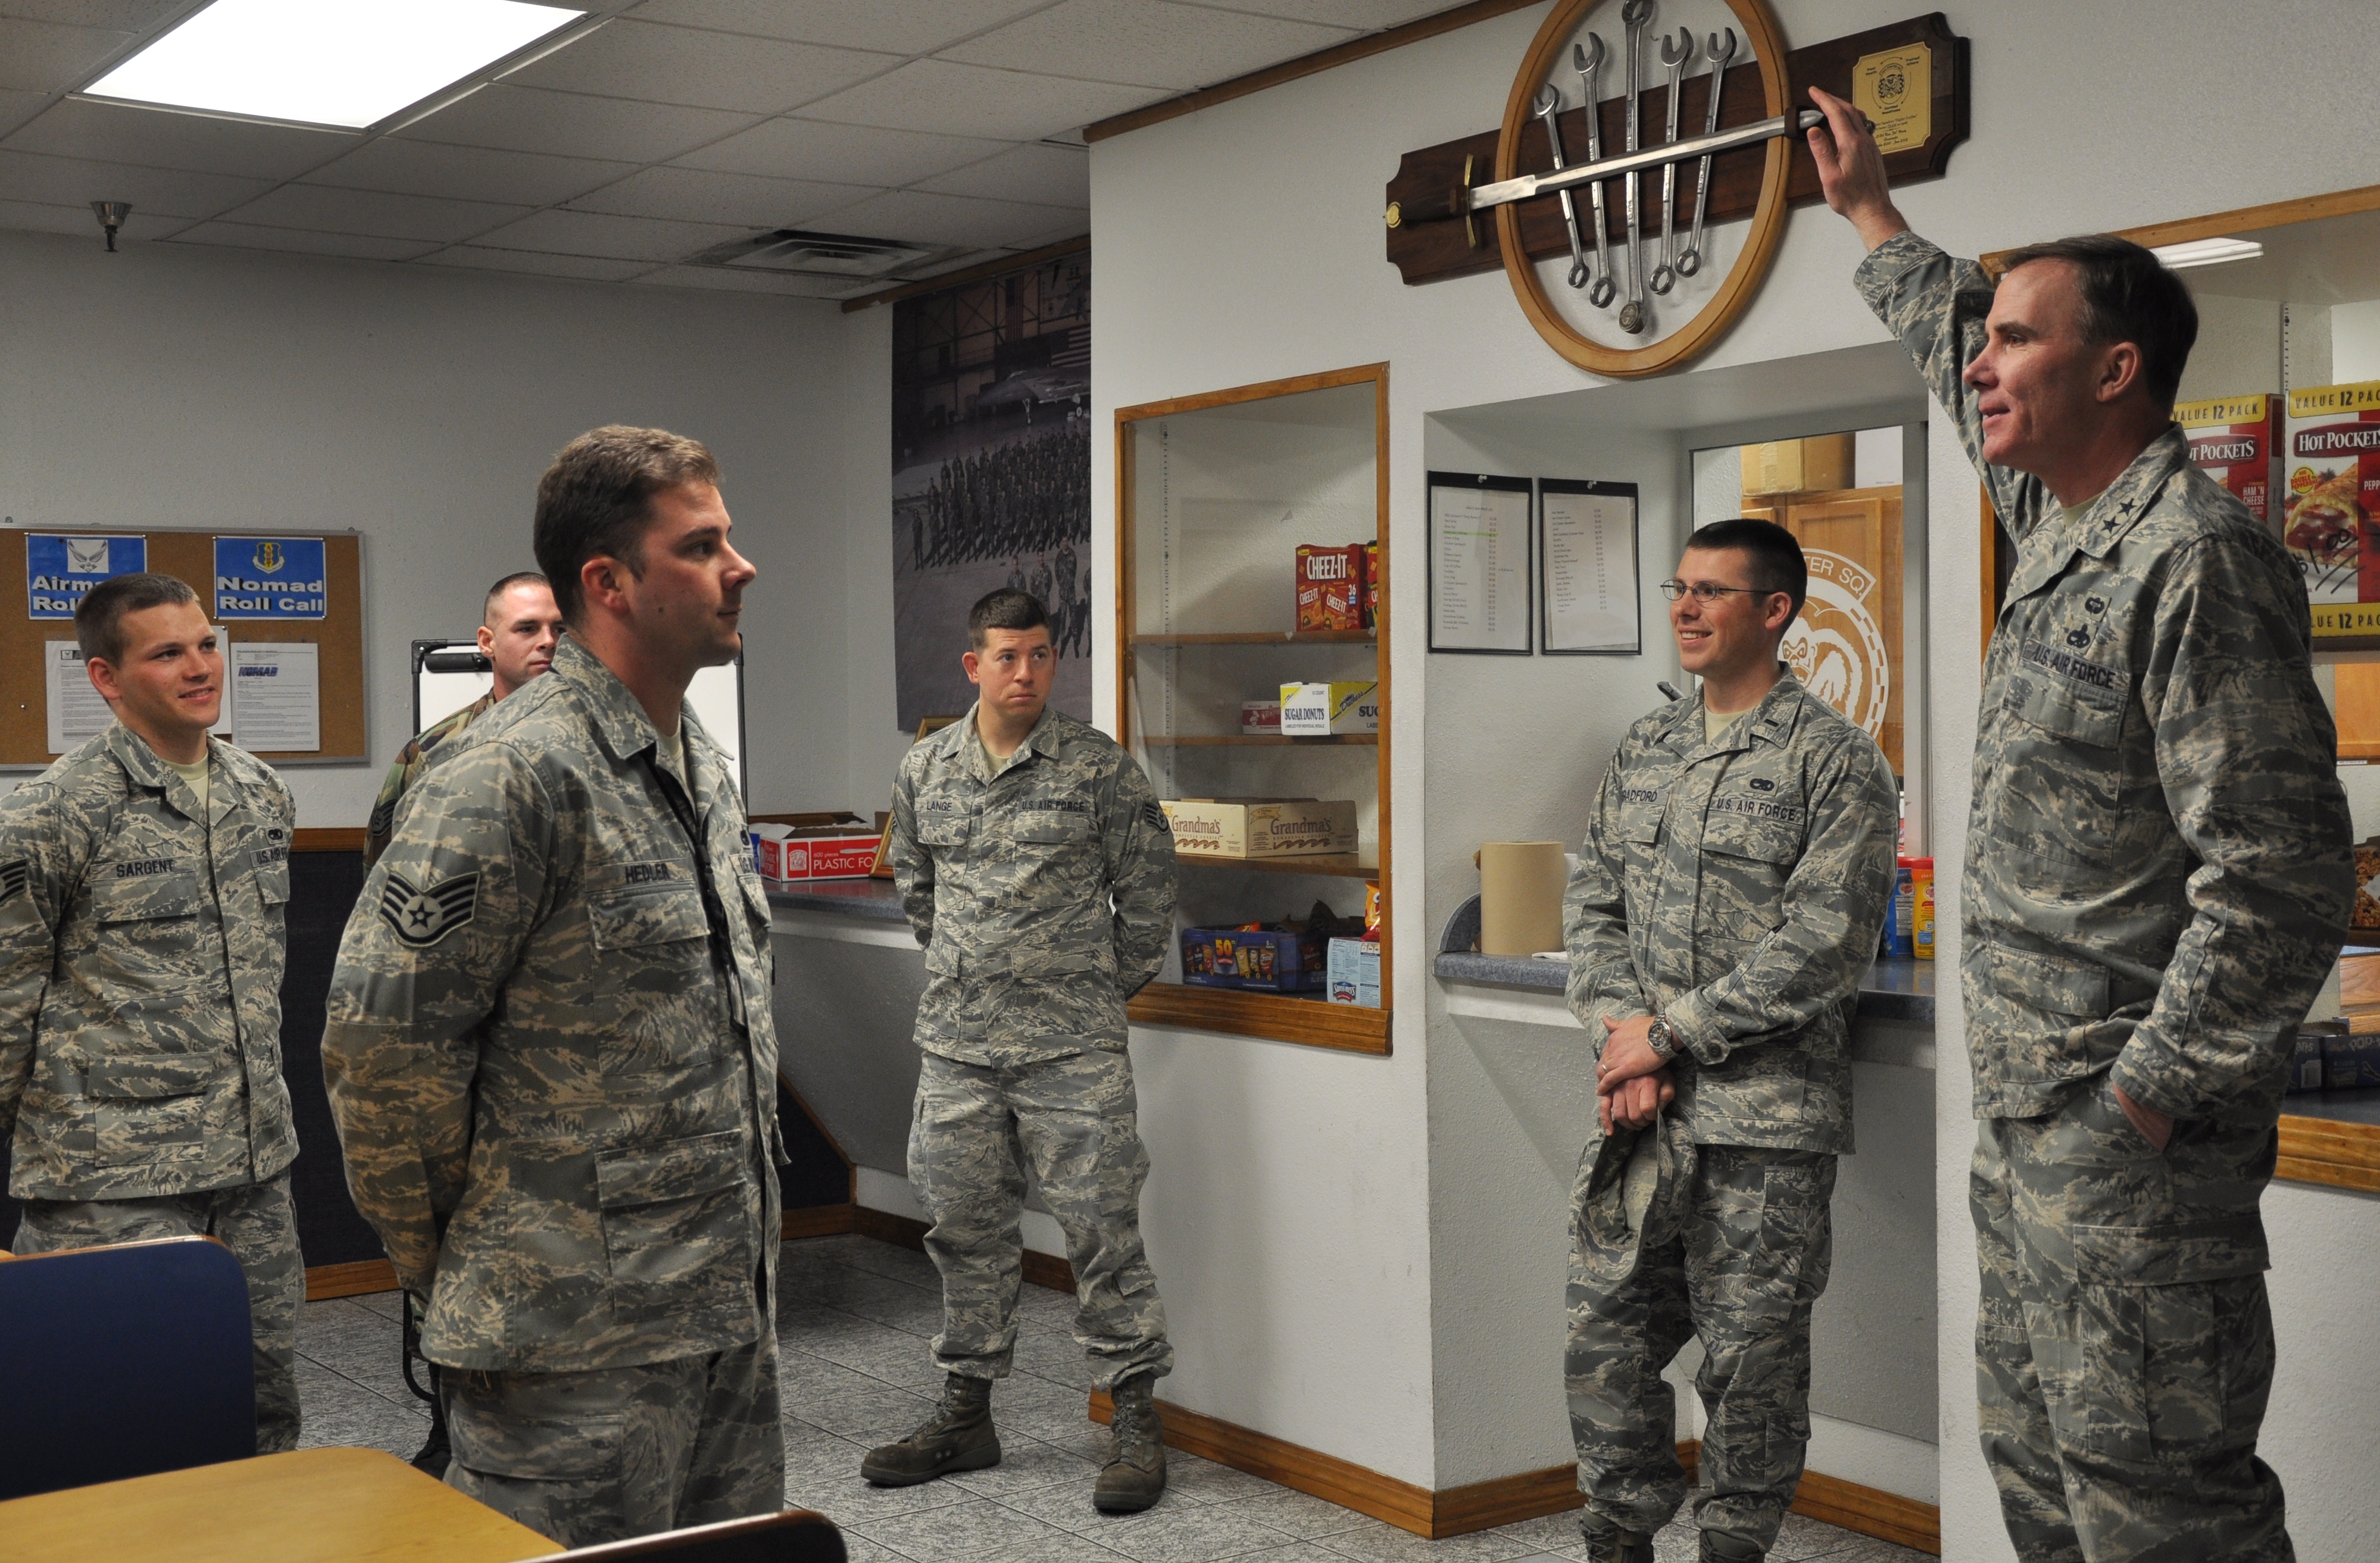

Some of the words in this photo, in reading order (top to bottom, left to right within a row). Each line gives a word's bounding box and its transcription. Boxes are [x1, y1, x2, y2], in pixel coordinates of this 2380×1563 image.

[2295, 393, 2334, 409] VALUE
[2340, 390, 2353, 407] 12
[2173, 408, 2208, 421] VALUE
[2213, 405, 2225, 420] 12
[2229, 403, 2259, 417] PACK
[2200, 440, 2254, 461] POCKETS
[2299, 434, 2325, 452] HOT
[2243, 486, 2256, 496] HAM
[2243, 495, 2265, 505] CHEESE
[32, 576, 102, 591] Airm
[217, 576, 323, 593] Nomad
[1348, 584, 1356, 595] 36
[33, 596, 79, 611] Rol
[220, 596, 270, 610] Roll
[279, 598, 323, 611] Call
[2338, 614, 2353, 629] 12
[2034, 644, 2051, 666] U.S.
[2051, 652, 2071, 674] AIR
[2070, 661, 2116, 689] FORCE
[1285, 708, 1303, 720] SUGAR
[1303, 708, 1325, 720] DONUTS
[1623, 789, 1658, 802] RADFORD
[926, 801, 952, 812] LANGE
[1022, 801, 1035, 810] U.S.
[1038, 801, 1052, 810] AIR
[1056, 801, 1085, 812] FORCE
[1716, 798, 1732, 810] U.S.
[1736, 800, 1754, 813] AIR
[1758, 802, 1797, 821] FORCE
[1172, 815, 1220, 834] Grandma's
[1270, 817, 1332, 834] Grandma's
[270, 848, 282, 863] AIR
[116, 859, 173, 878] SARGENT
[813, 858, 855, 870] PLASTIC
[626, 862, 670, 884] HEDLER
[1215, 939, 1232, 956] 50
